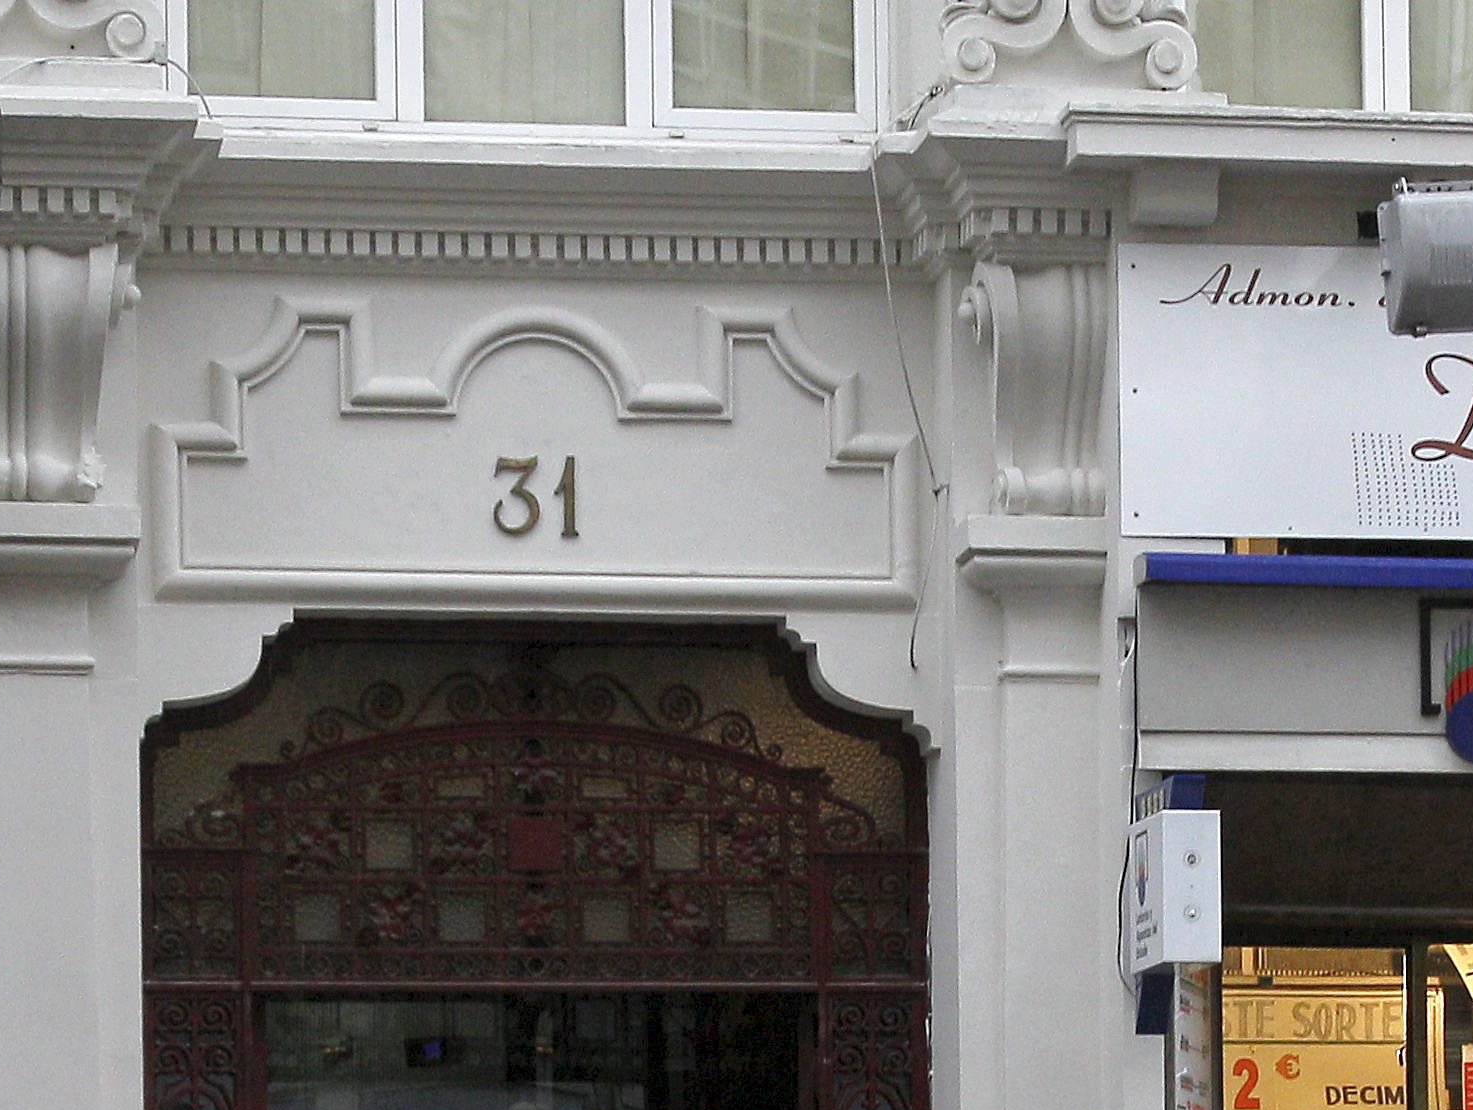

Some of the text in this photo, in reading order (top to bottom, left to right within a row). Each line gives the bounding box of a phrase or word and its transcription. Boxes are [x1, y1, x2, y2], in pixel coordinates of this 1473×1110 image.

[1160, 263, 1357, 307] Admon.
[492, 454, 581, 539] 31
[1232, 1053, 1301, 1110] 2 €
